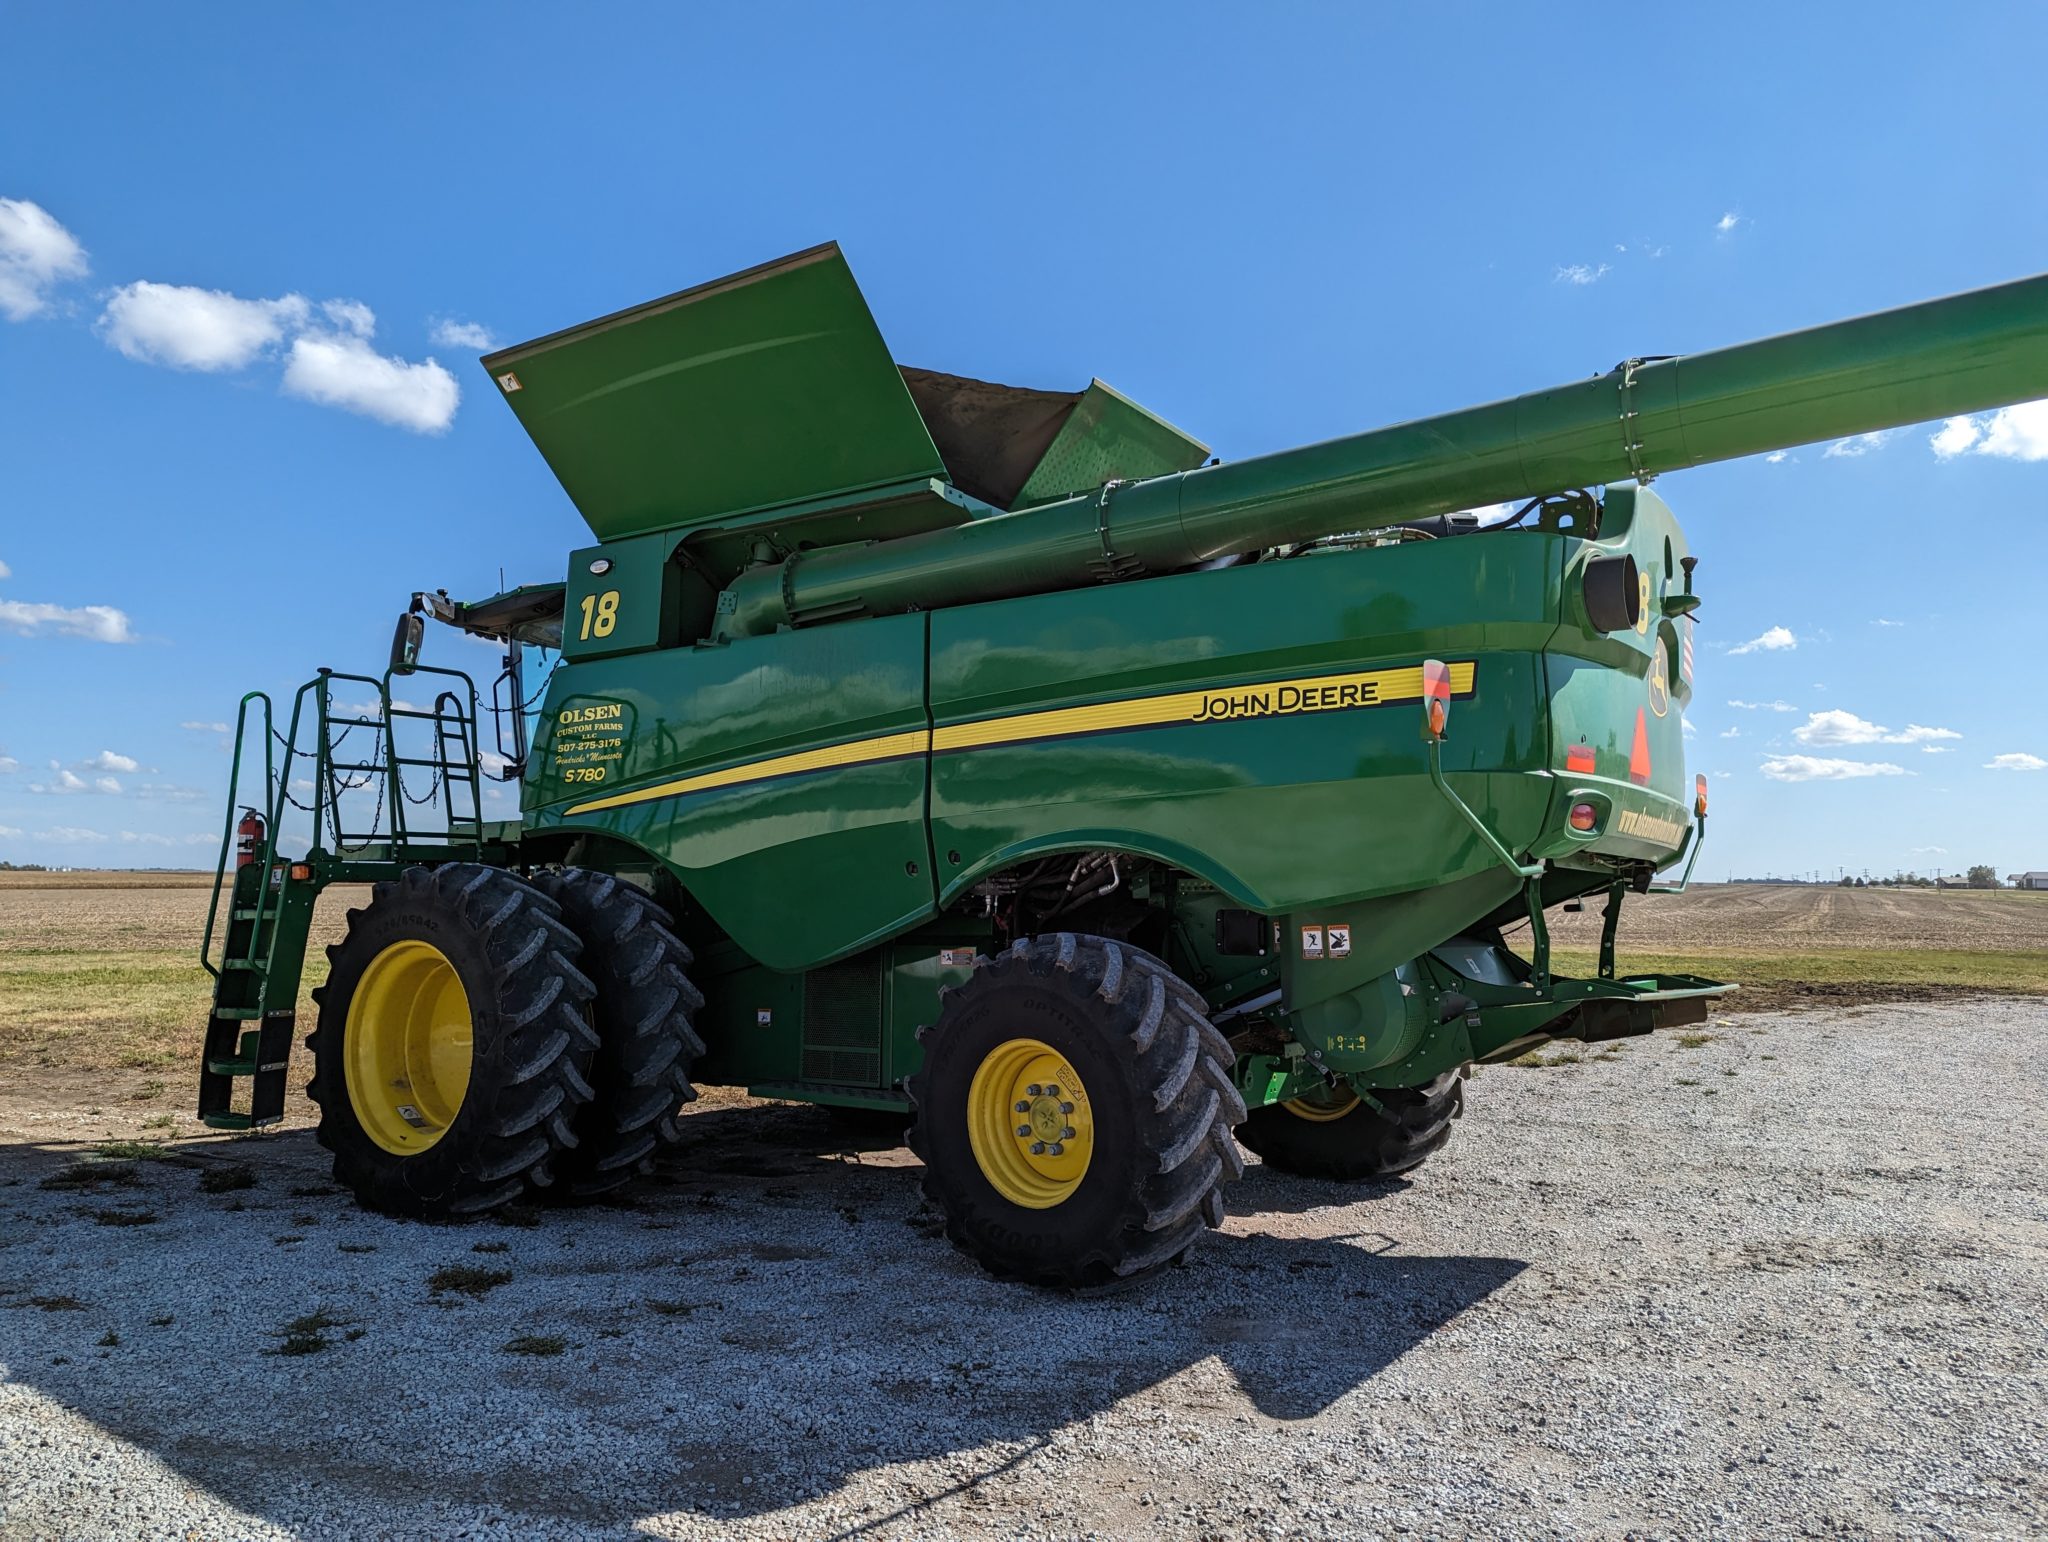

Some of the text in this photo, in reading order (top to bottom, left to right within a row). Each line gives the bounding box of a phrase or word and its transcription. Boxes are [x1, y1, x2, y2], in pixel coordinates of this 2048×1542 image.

[580, 590, 620, 640] 18
[1193, 682, 1378, 719] JOHN DEERE
[559, 704, 622, 724] OLSEN
[556, 723, 624, 738] CUSTOM FARMS
[582, 732, 598, 740] LLC
[557, 738, 622, 753] 507-275-3176
[564, 767, 606, 783] S780
